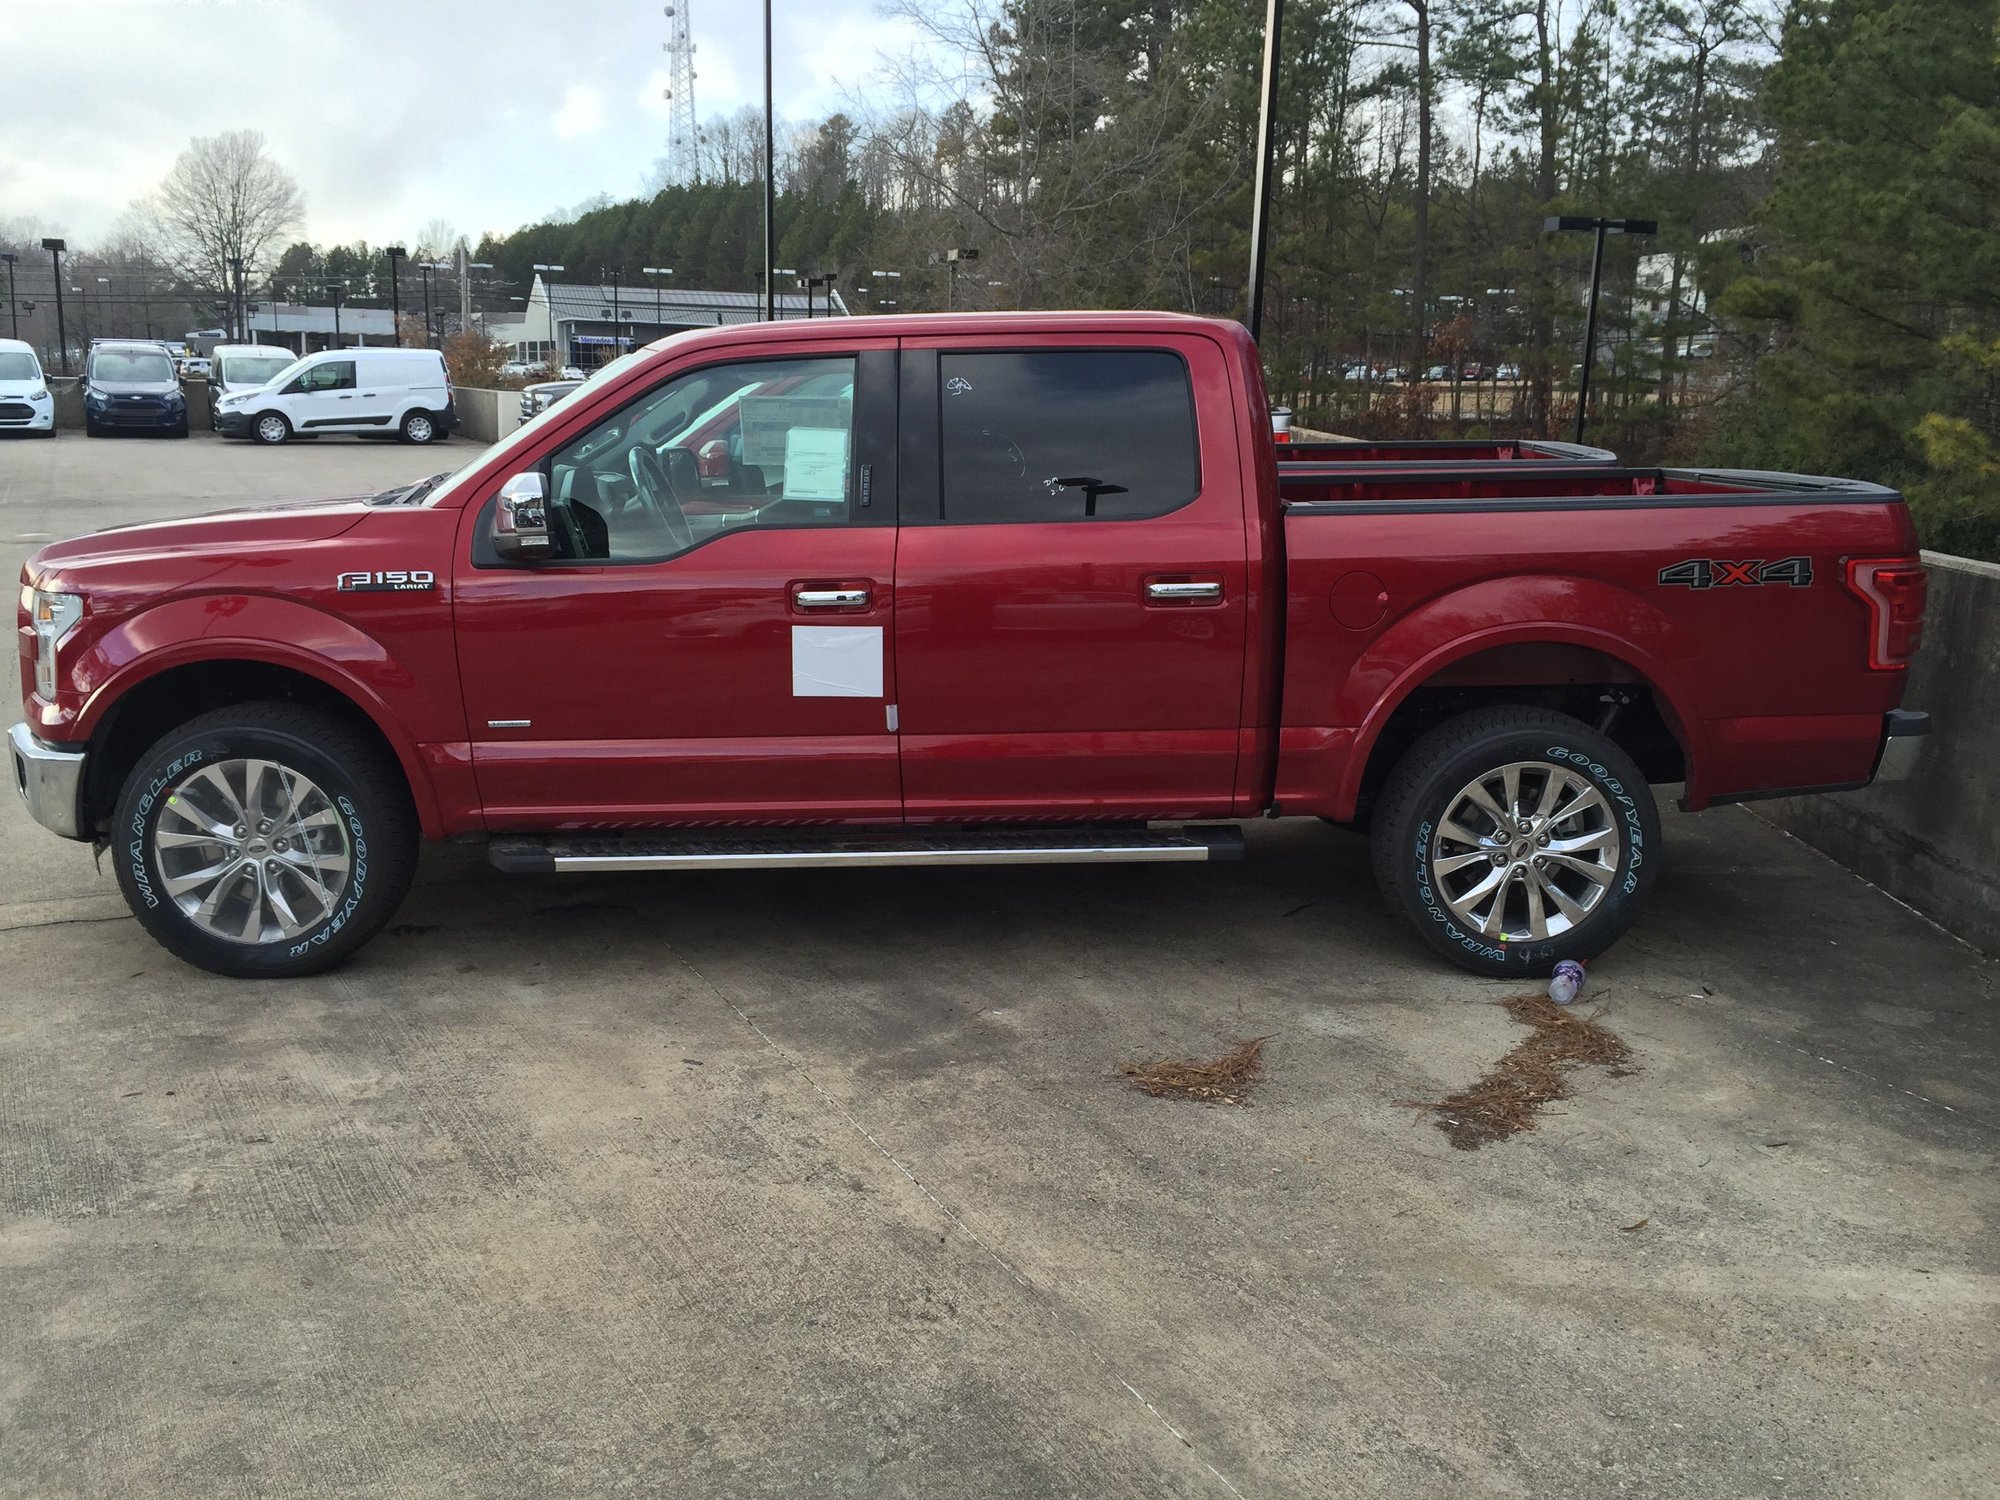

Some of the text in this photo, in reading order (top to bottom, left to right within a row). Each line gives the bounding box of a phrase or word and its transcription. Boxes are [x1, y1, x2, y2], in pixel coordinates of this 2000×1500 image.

[129, 749, 203, 908] WRANGLER
[289, 794, 369, 958] GOODYEAR
[1414, 820, 1506, 962] WRANGLER
[1546, 746, 1644, 894] GOODYEAR
